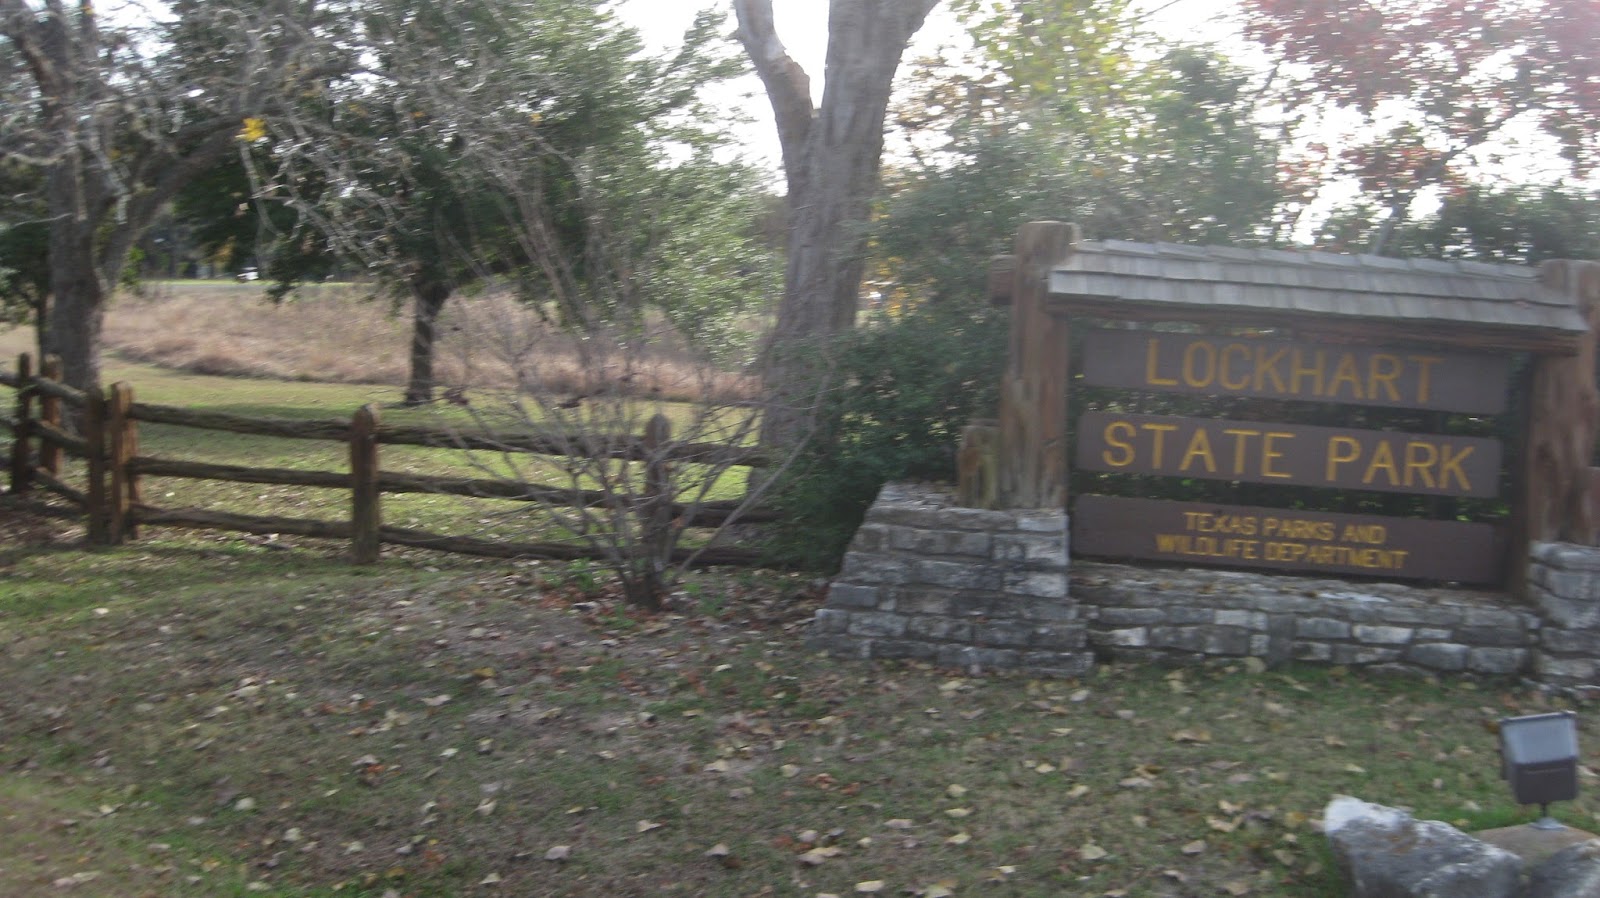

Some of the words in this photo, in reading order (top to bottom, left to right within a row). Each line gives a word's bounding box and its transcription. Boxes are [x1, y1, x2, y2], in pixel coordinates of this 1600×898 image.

[1145, 338, 1446, 403] LOCKHART
[1102, 421, 1296, 478] STATE
[1325, 435, 1476, 491] PARK
[1155, 535, 1256, 560] WILDLIFE
[1264, 542, 1409, 569] DEPARTMENT
[1183, 511, 1259, 535] TEXAS
[1262, 518, 1335, 541] PARKS
[1343, 525, 1387, 544] AND
